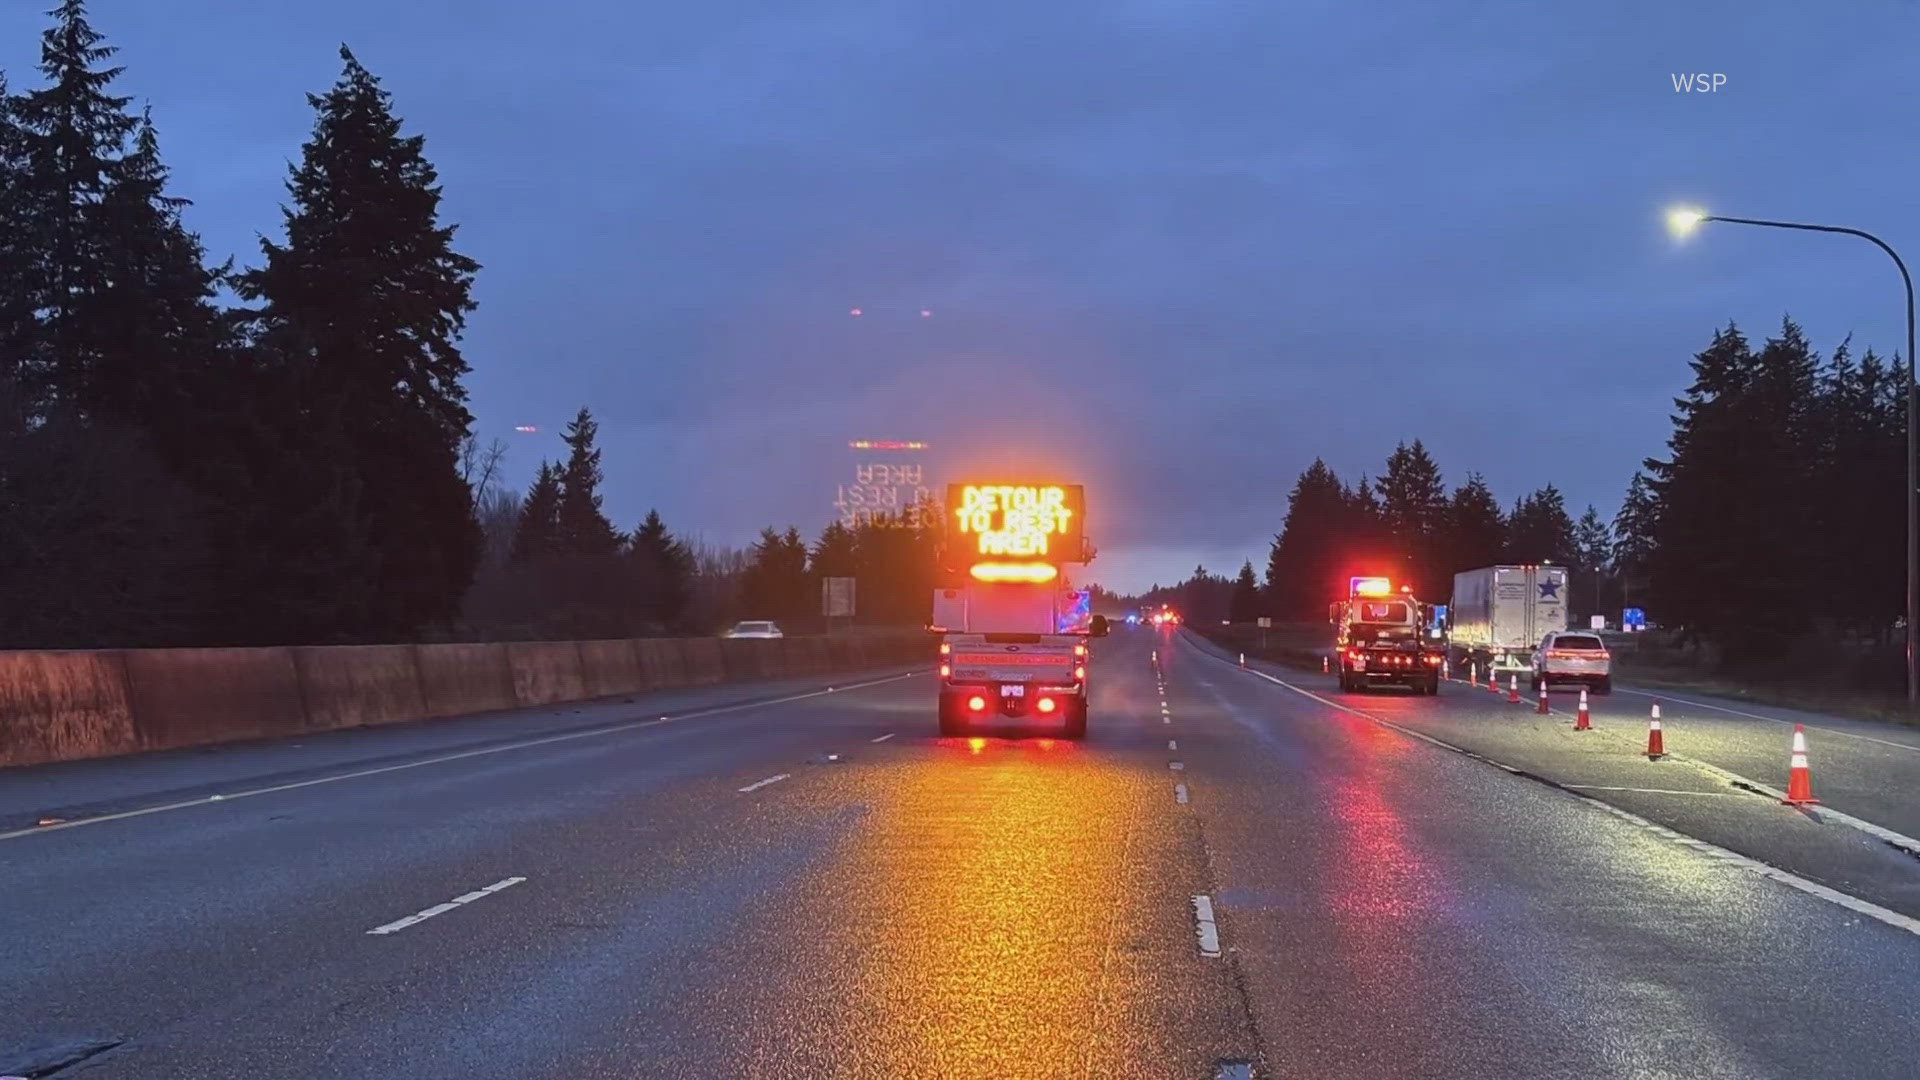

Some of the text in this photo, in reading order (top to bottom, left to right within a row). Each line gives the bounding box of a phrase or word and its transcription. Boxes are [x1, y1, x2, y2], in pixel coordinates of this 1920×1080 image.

[963, 486, 1064, 511] DETOUR
[955, 507, 1072, 534] TO REST
[979, 531, 1047, 556] AREA
